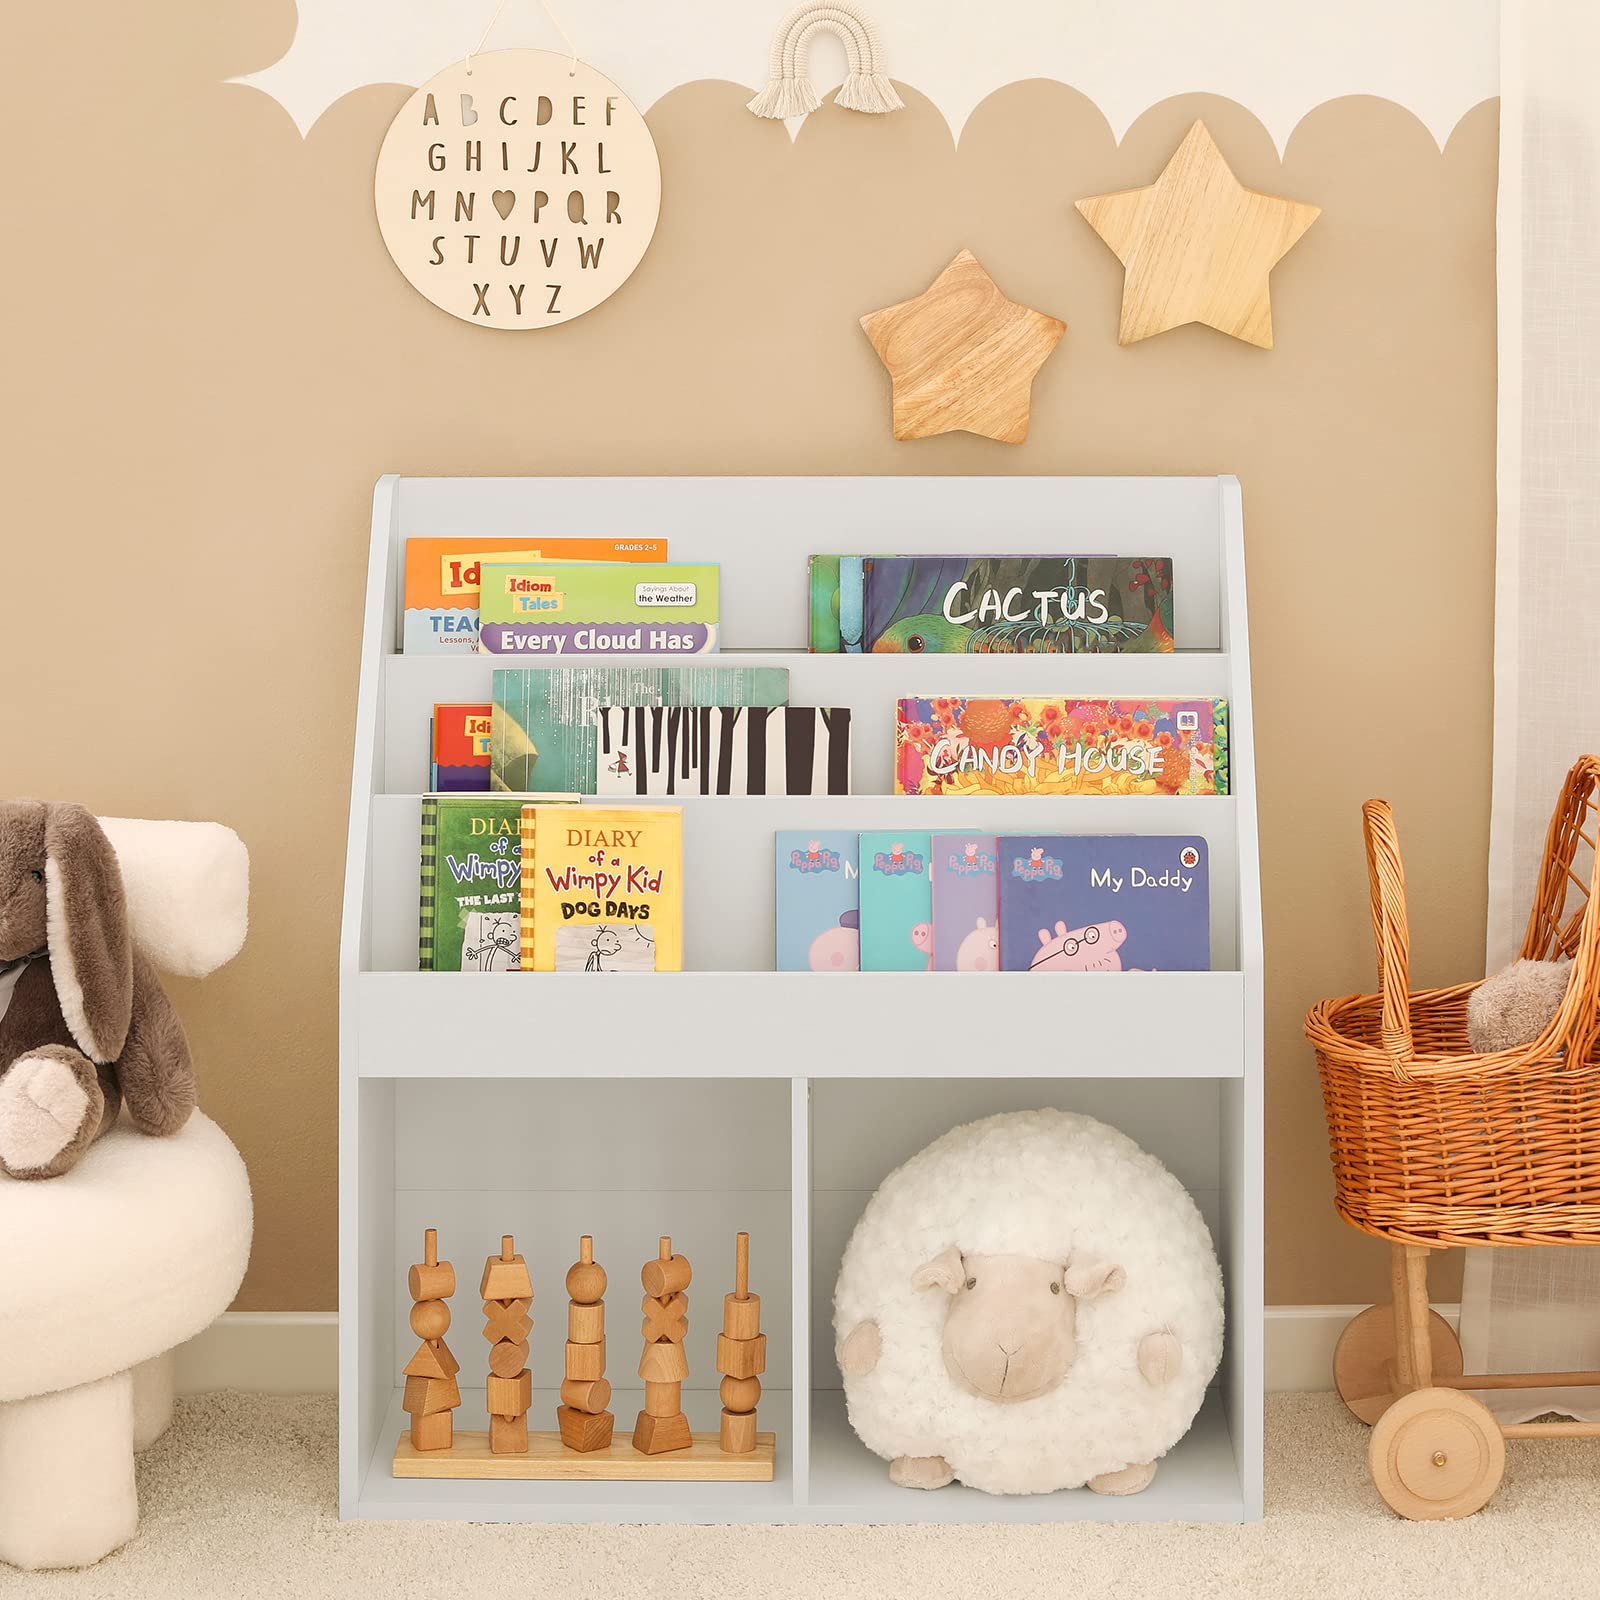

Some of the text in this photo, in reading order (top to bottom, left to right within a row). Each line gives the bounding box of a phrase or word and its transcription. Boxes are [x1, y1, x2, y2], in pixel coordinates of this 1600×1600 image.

[509, 579, 552, 592] Idiom
[519, 597, 558, 611] Tales
[638, 594, 693, 602] the Weather
[942, 581, 1109, 626] CACTUS
[501, 631, 567, 654] Every
[574, 629, 642, 650] Cloud
[649, 631, 694, 650] Has
[930, 739, 1044, 777] CANDY
[1058, 743, 1165, 775] HOUSE
[490, 837, 508, 855] of
[567, 829, 643, 847] DIARY
[588, 850, 620, 866] of a
[791, 851, 839, 873] Peppa Pig
[875, 853, 905, 875] Peppa
[905, 852, 922, 872] Pig
[949, 855, 979, 875] Peppa
[446, 854, 521, 888] Wimpy
[1014, 859, 1062, 879] Peppa Pig
[545, 865, 663, 899] Wimpy Kid
[1091, 867, 1193, 893] My Daddy
[456, 896, 482, 908] THE
[484, 893, 515, 906] LAST
[561, 901, 650, 920] DOG DAYS
